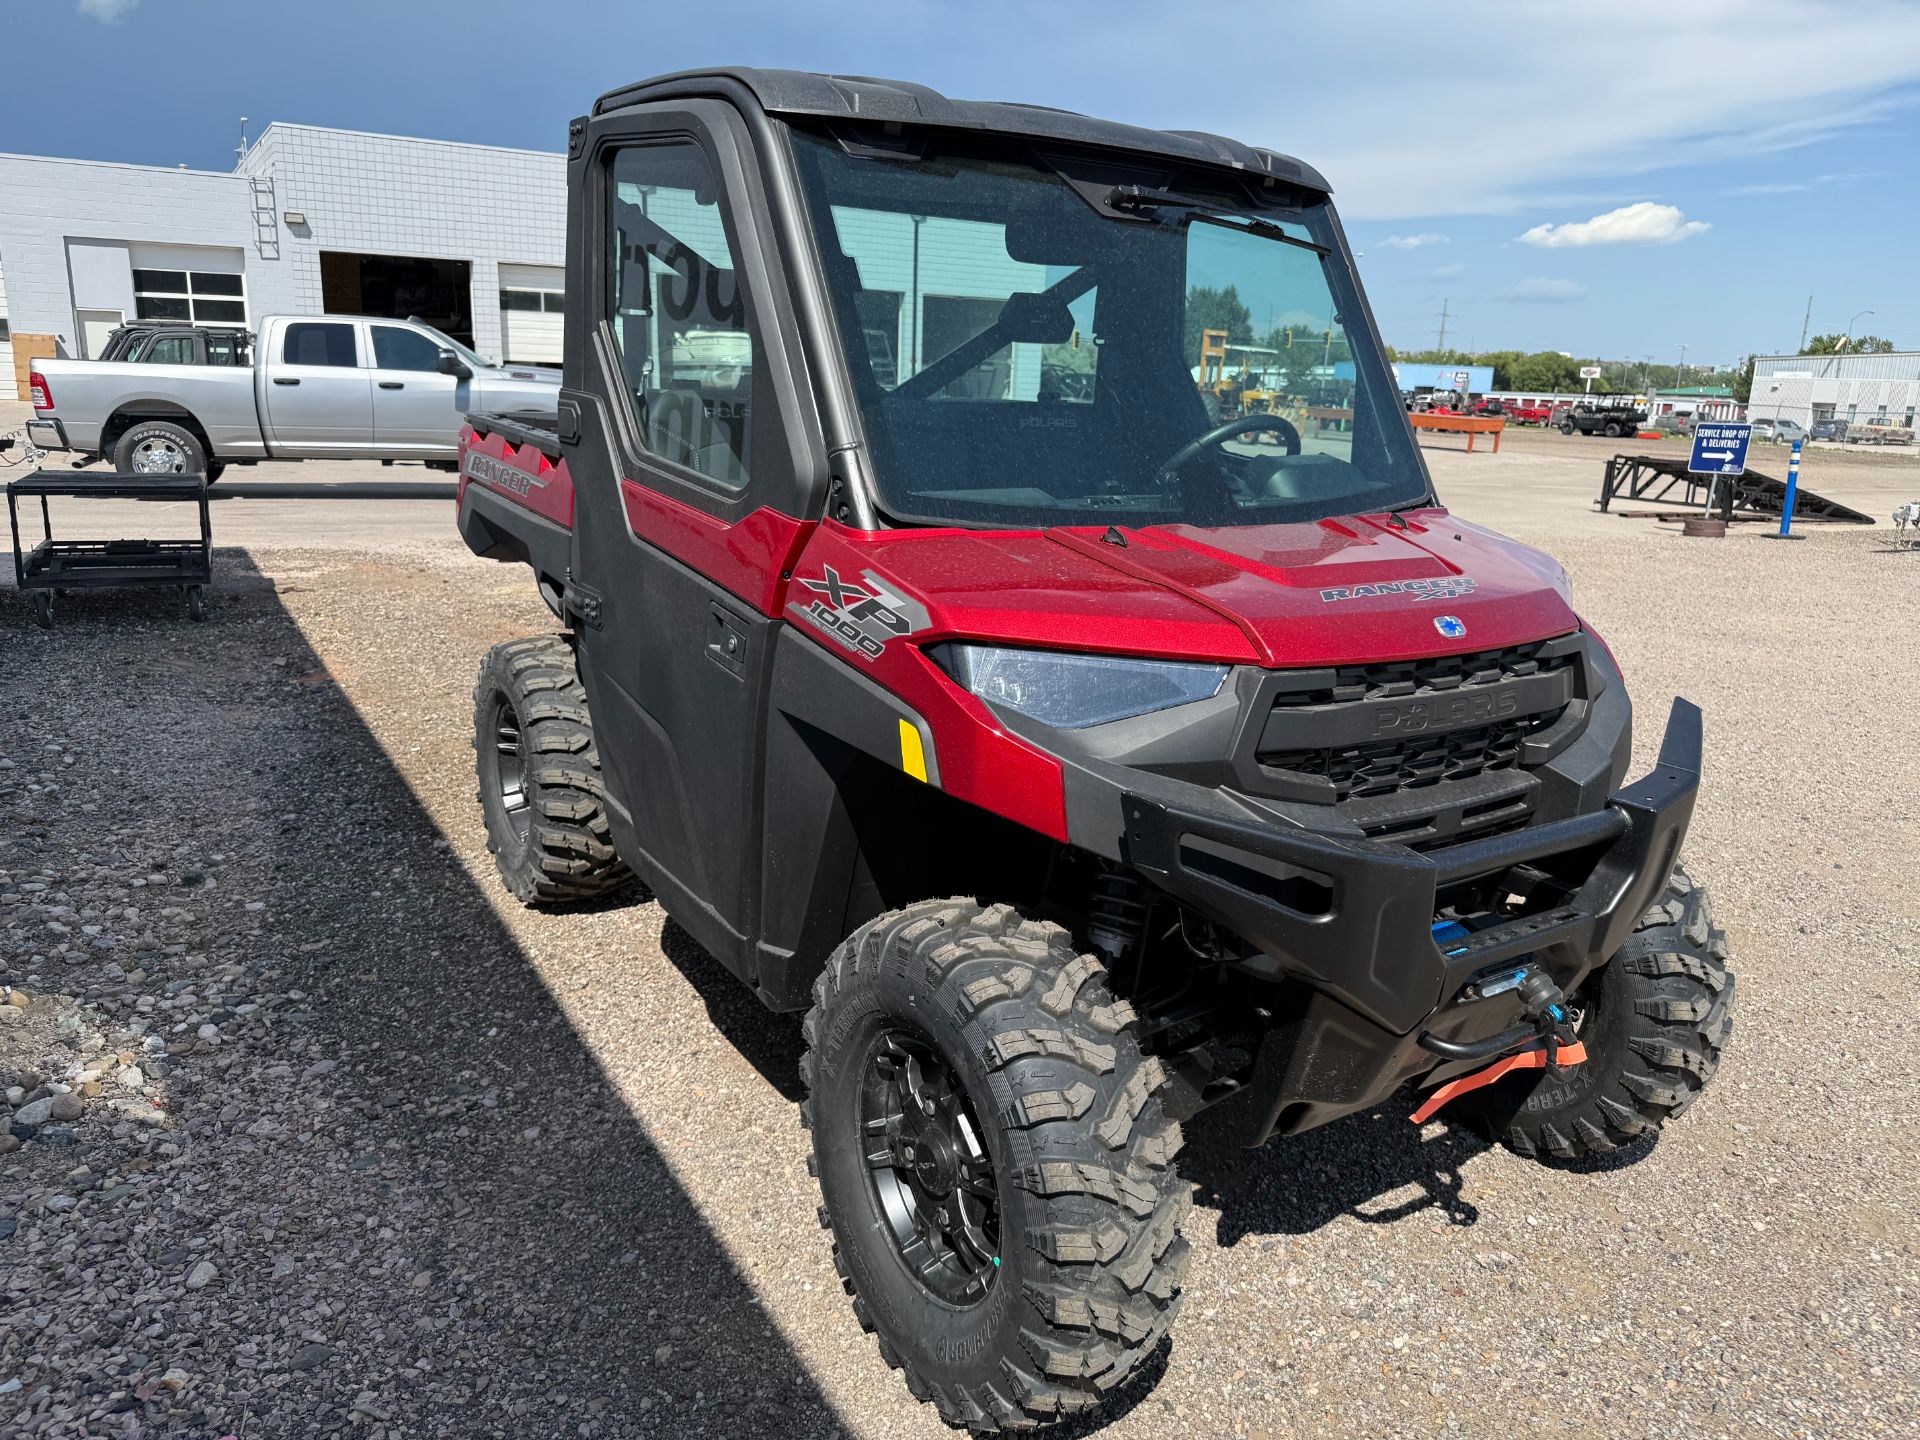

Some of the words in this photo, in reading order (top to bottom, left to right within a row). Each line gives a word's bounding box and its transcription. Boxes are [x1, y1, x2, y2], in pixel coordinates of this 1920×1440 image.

[1020, 415, 1077, 428] POLARIS
[1698, 429, 1720, 438] SERVICE
[1721, 430, 1737, 438] DROP
[1738, 430, 1749, 439] OFF
[1702, 439, 1707, 447] &
[1709, 439, 1740, 448] DELIVERIES
[470, 454, 531, 498] RANGER
[795, 563, 912, 636] XP
[1320, 577, 1478, 603] RANGER
[1412, 588, 1475, 602] XP
[806, 615, 823, 629] DUAL
[822, 626, 857, 651] OVERHEAD
[857, 650, 875, 663] CAM
[809, 599, 886, 658] 1000
[1372, 687, 1517, 736] POLARIS
[1527, 1066, 1595, 1112] X-TERR
